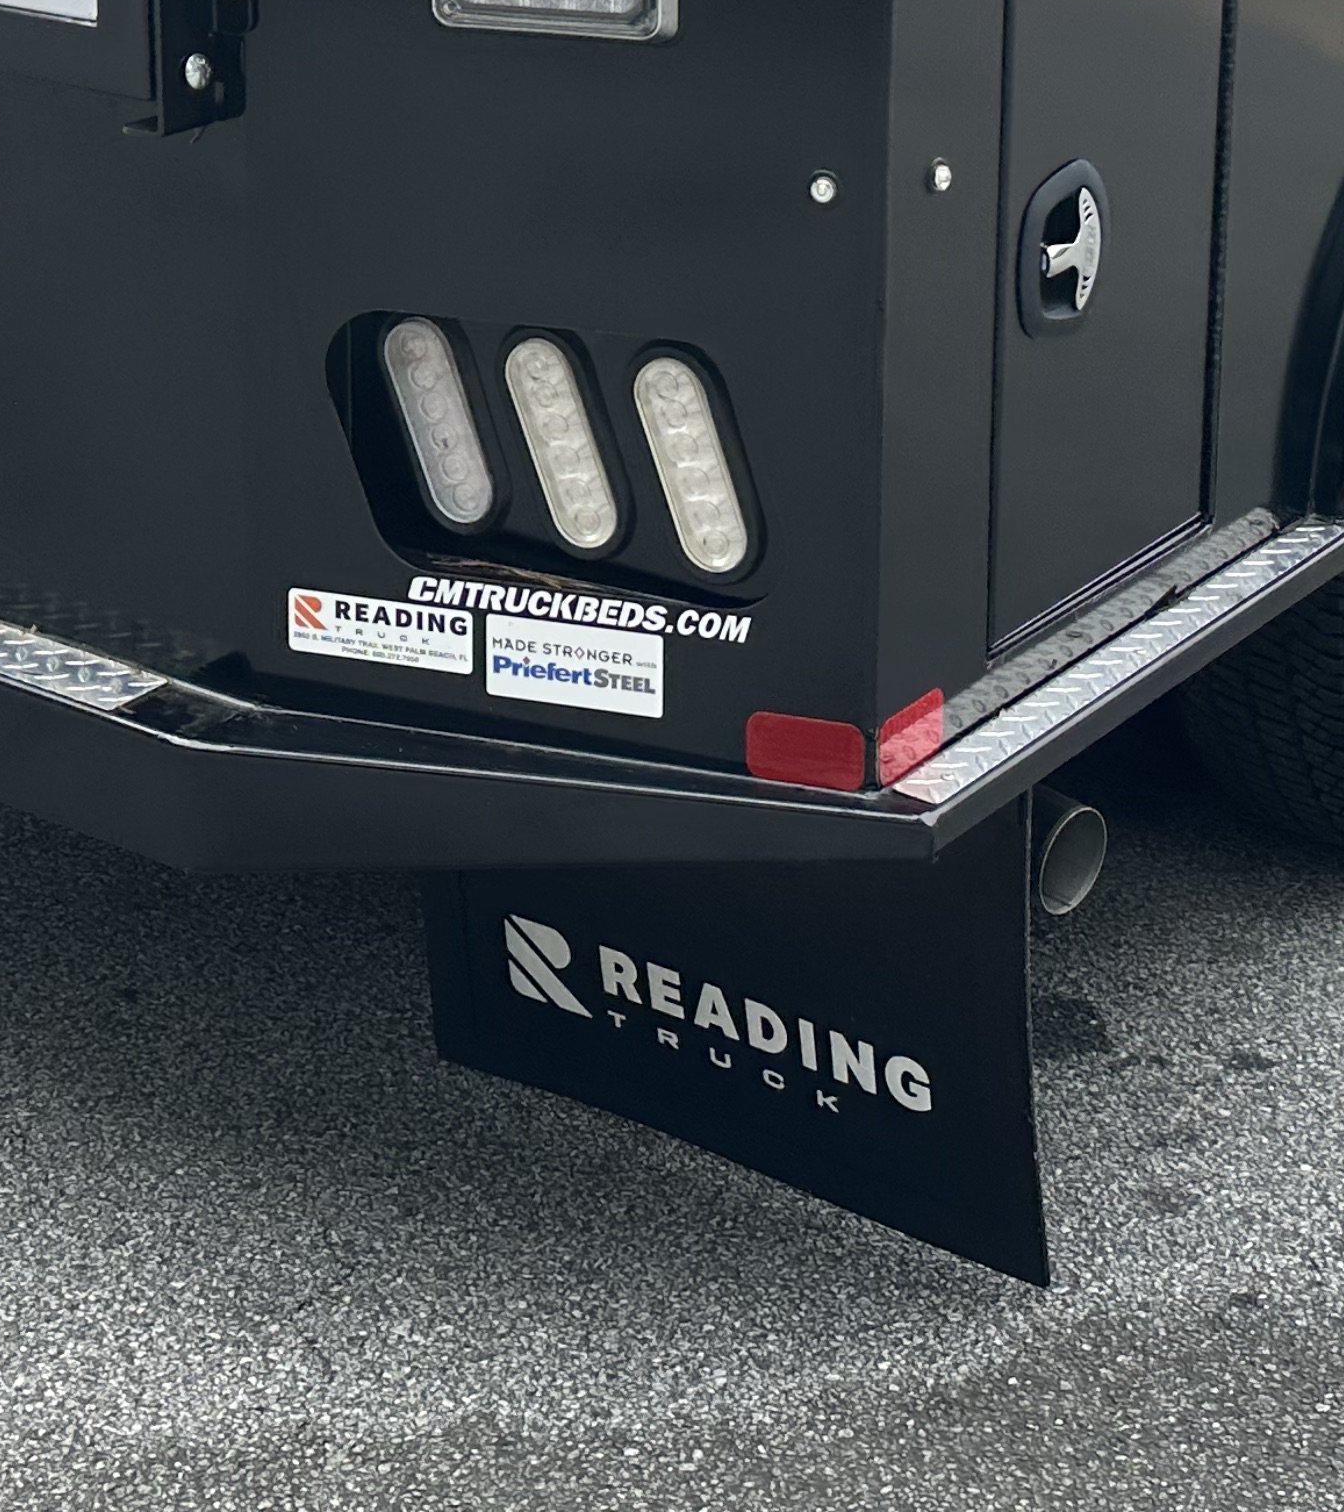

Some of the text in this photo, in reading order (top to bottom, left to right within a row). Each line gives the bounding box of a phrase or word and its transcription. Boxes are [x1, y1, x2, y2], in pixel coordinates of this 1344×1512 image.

[335, 600, 468, 636] READING
[407, 575, 752, 644] CMTRUCKBEDS.COM
[335, 625, 430, 645] TRUCK
[382, 643, 403, 653] WEST
[405, 646, 427, 655] PALM
[492, 637, 537, 653] MADE
[542, 643, 633, 666] STRONGER
[598, 944, 932, 1112] READING
[607, 1009, 840, 1113] TRUCK
